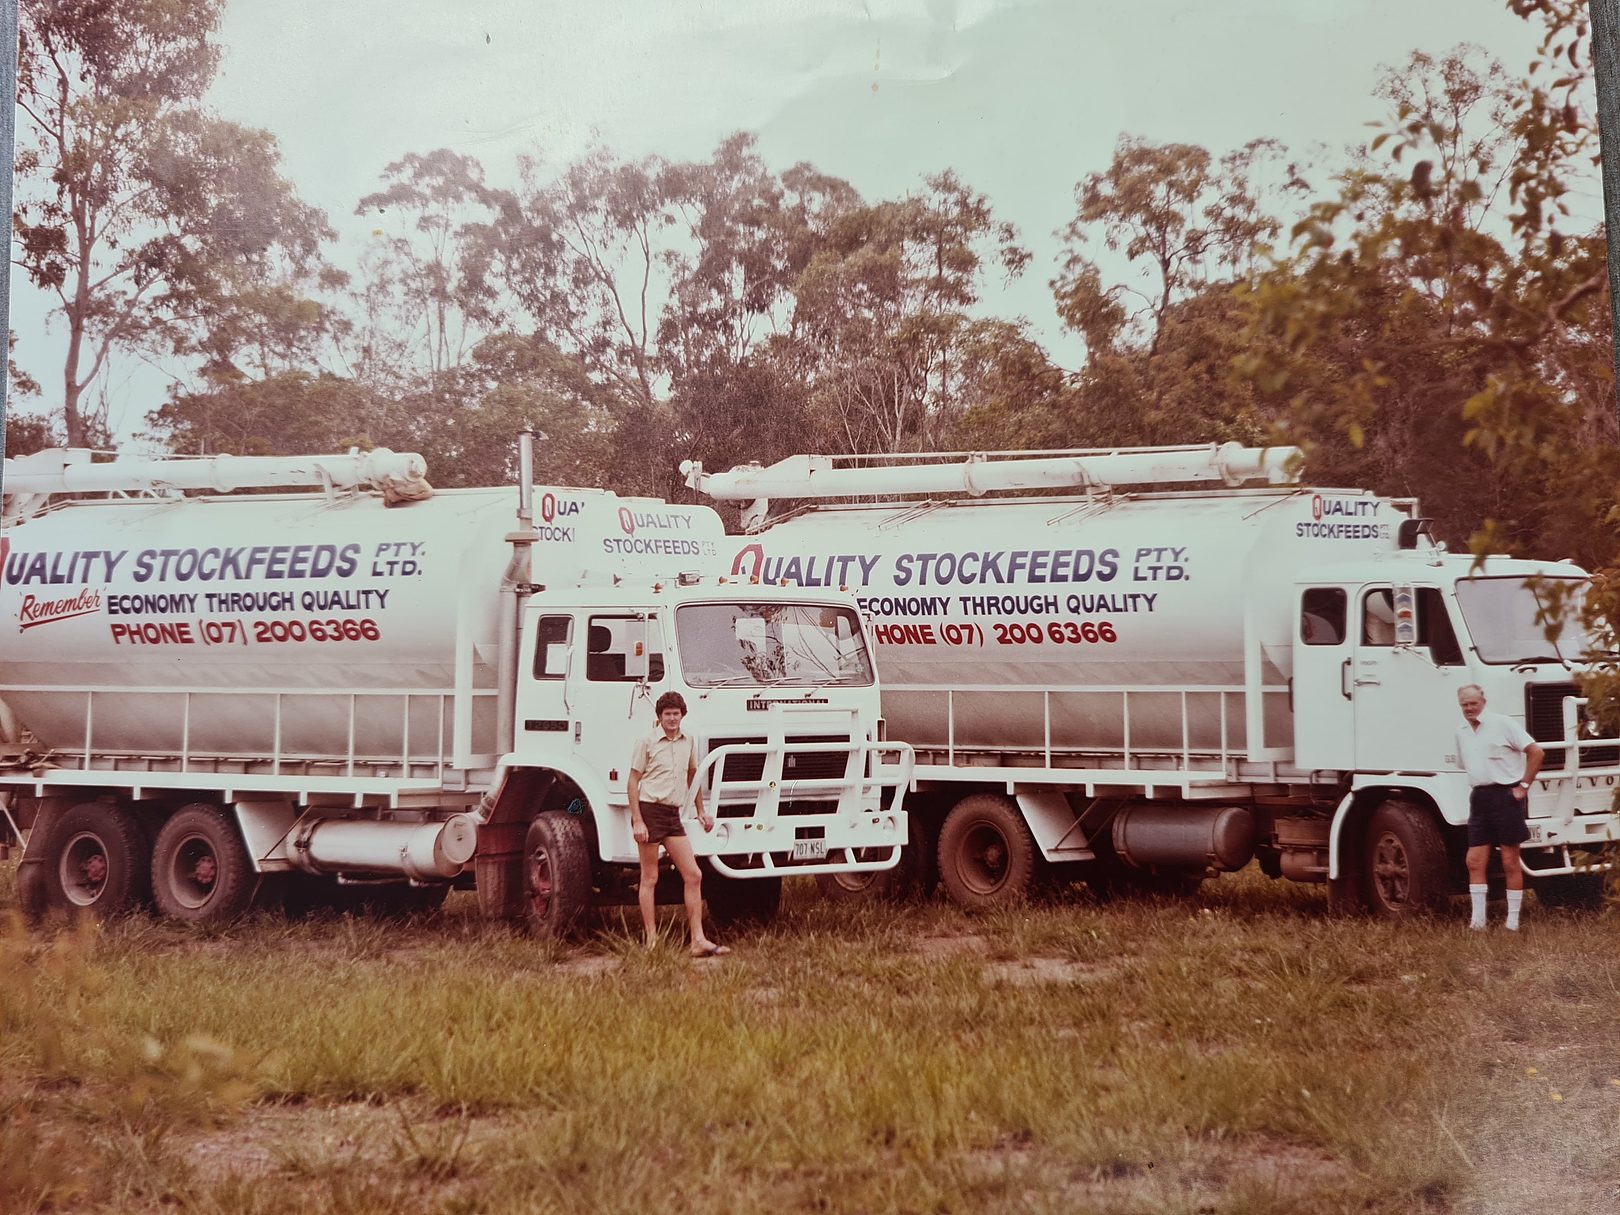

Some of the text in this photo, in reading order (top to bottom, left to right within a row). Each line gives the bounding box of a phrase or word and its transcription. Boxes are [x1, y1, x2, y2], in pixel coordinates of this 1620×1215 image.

[1313, 495, 1380, 521] QUALITY
[618, 507, 691, 538] QUALITY
[1296, 523, 1379, 539] STOCKFEEDS
[375, 542, 426, 558] PTY.
[603, 539, 700, 555] STOCKFEEDS
[1135, 546, 1189, 563] PTY.
[0, 537, 361, 590] UALITY STOCKFEEDS
[371, 560, 422, 577] LTD.
[731, 544, 1120, 587] QUALITY STOCKFEEDS
[1133, 565, 1190, 581] LTD.
[107, 589, 390, 615] ECONOMY THROUGH QUALITY
[857, 593, 1157, 617] ECONOMY THROUGH QUALITY
[110, 622, 196, 645] PHONE
[199, 619, 249, 646] (07)
[866, 623, 937, 646] HONE
[939, 621, 984, 647] (07)
[1540, 776, 1614, 791] VLVO
[795, 842, 825, 856] 707 NSL
